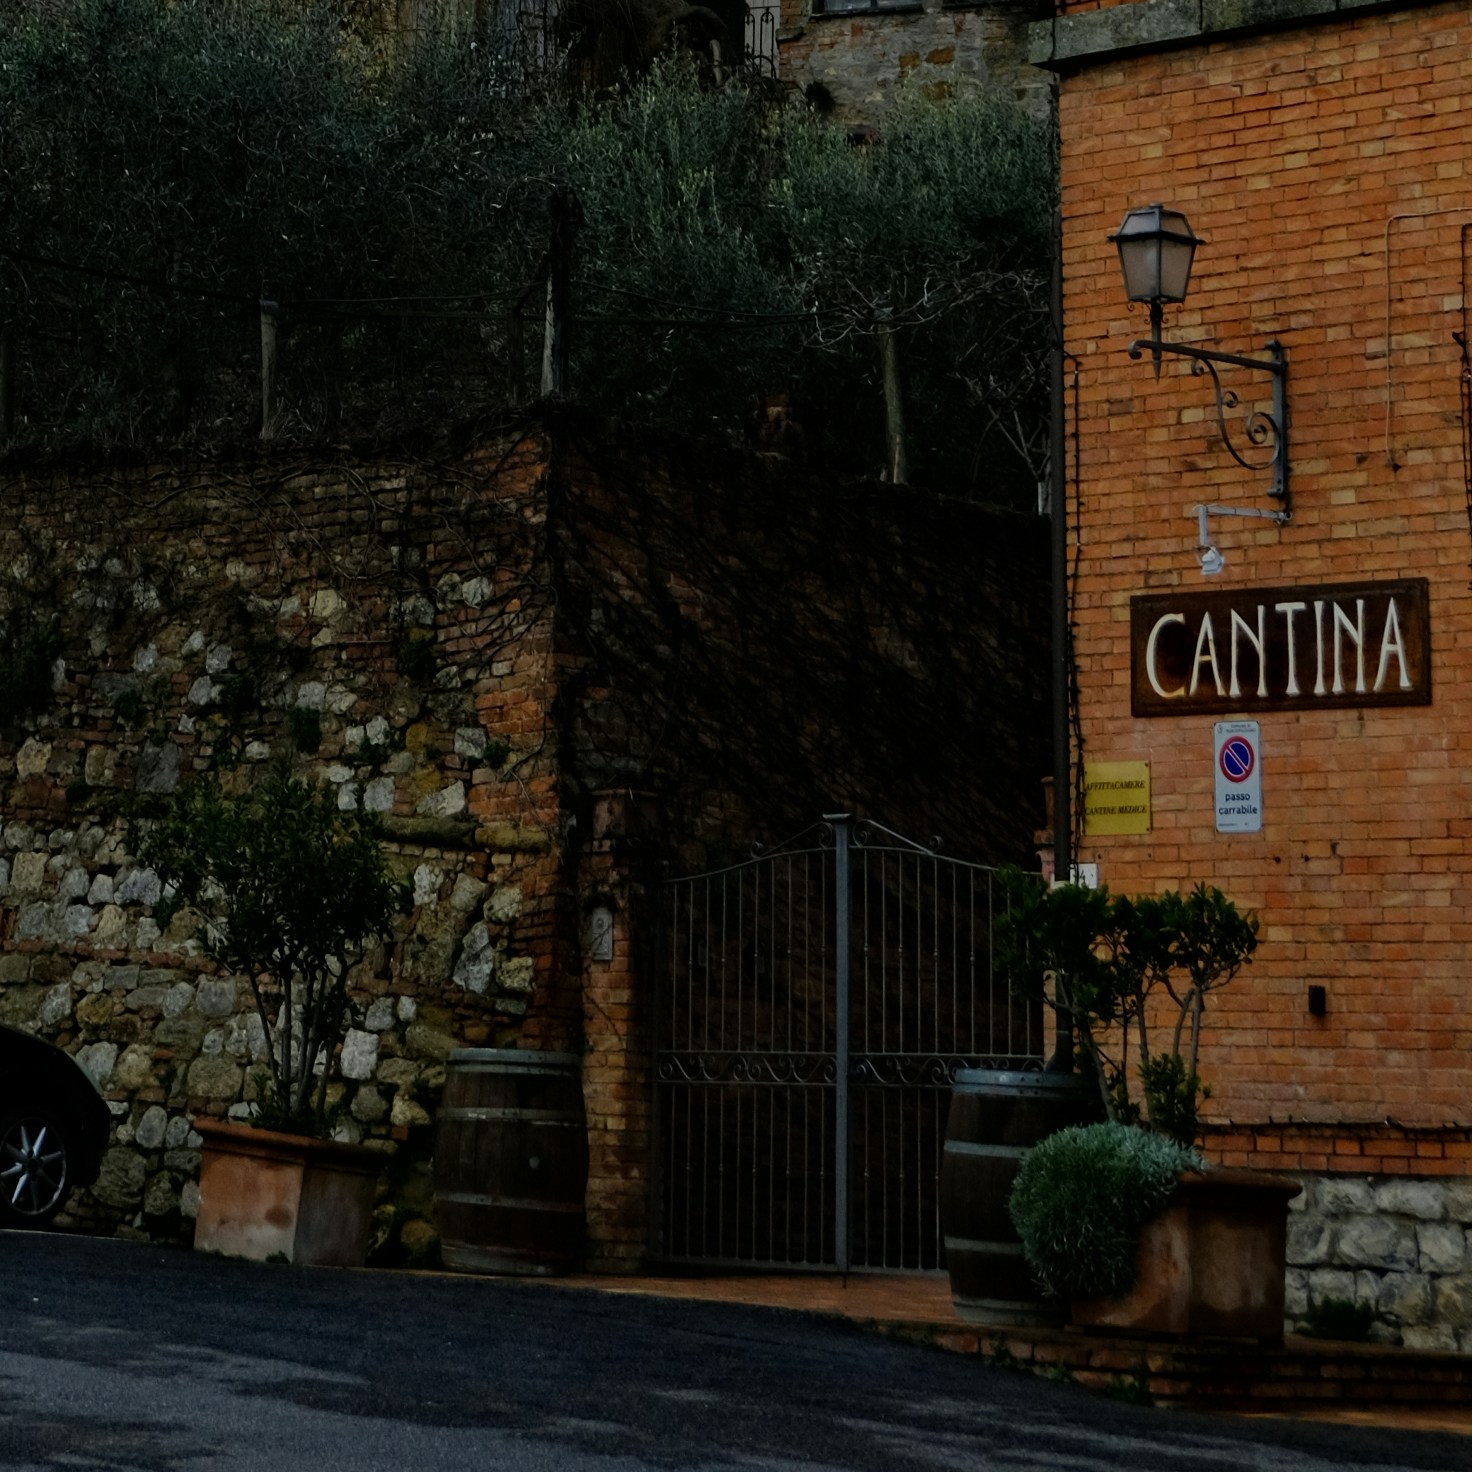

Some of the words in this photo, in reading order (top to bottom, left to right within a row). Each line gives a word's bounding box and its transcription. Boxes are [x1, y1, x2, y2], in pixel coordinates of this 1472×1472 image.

[1146, 596, 1414, 698] CANTINA
[1225, 793, 1250, 802] passo
[1085, 806, 1116, 816] CANTINE
[1218, 804, 1258, 815] carrabile
